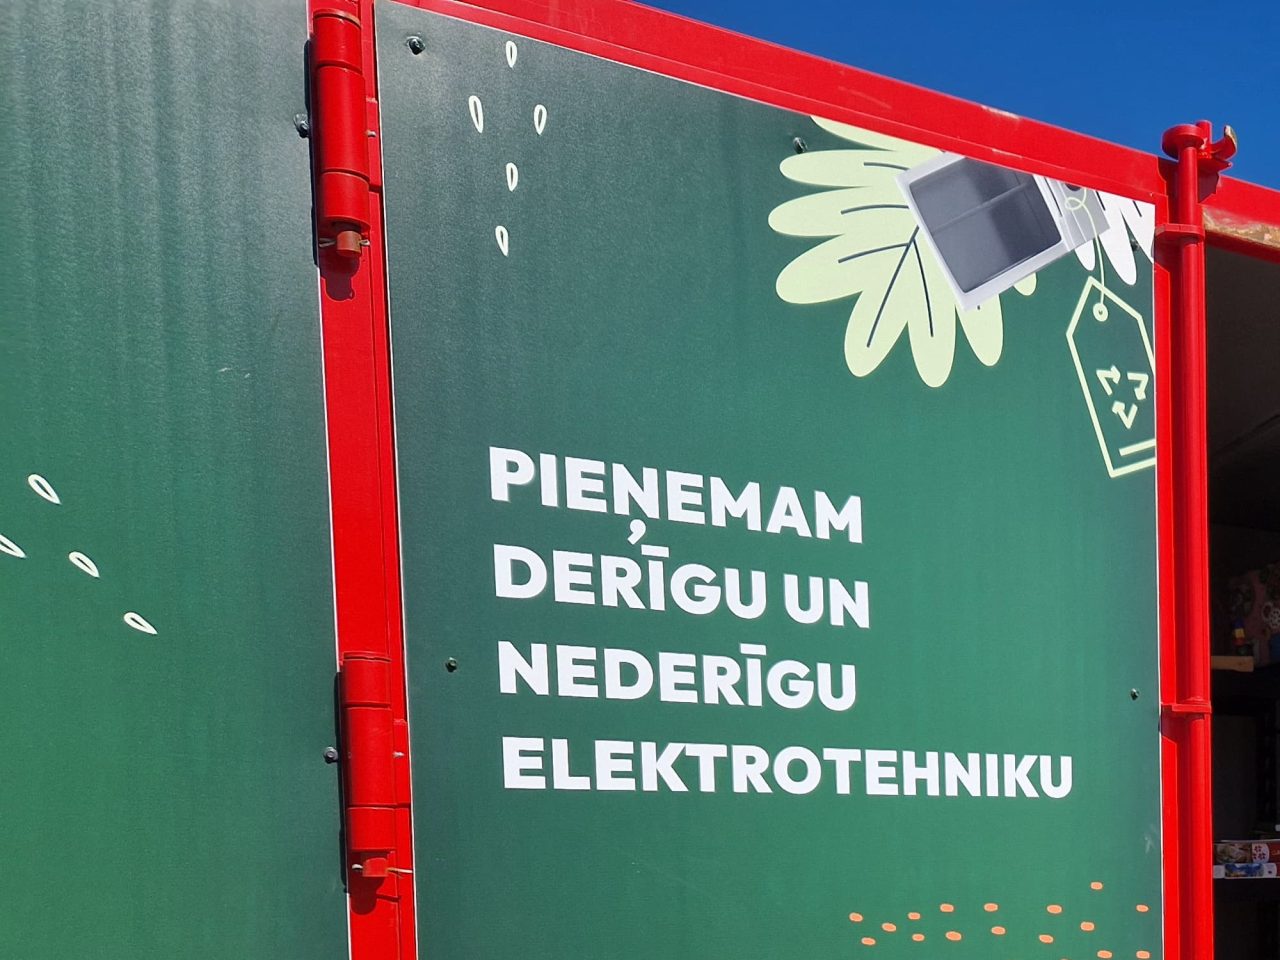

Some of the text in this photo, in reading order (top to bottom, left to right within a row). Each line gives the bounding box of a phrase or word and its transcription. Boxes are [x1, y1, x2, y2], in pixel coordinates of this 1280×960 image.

[489, 446, 863, 544] PIEŅEMAM
[492, 544, 870, 629] DERĪGU UN
[497, 640, 857, 712] NEDERĪGU
[502, 736, 1073, 799] ELEKTROTEHNIKU
